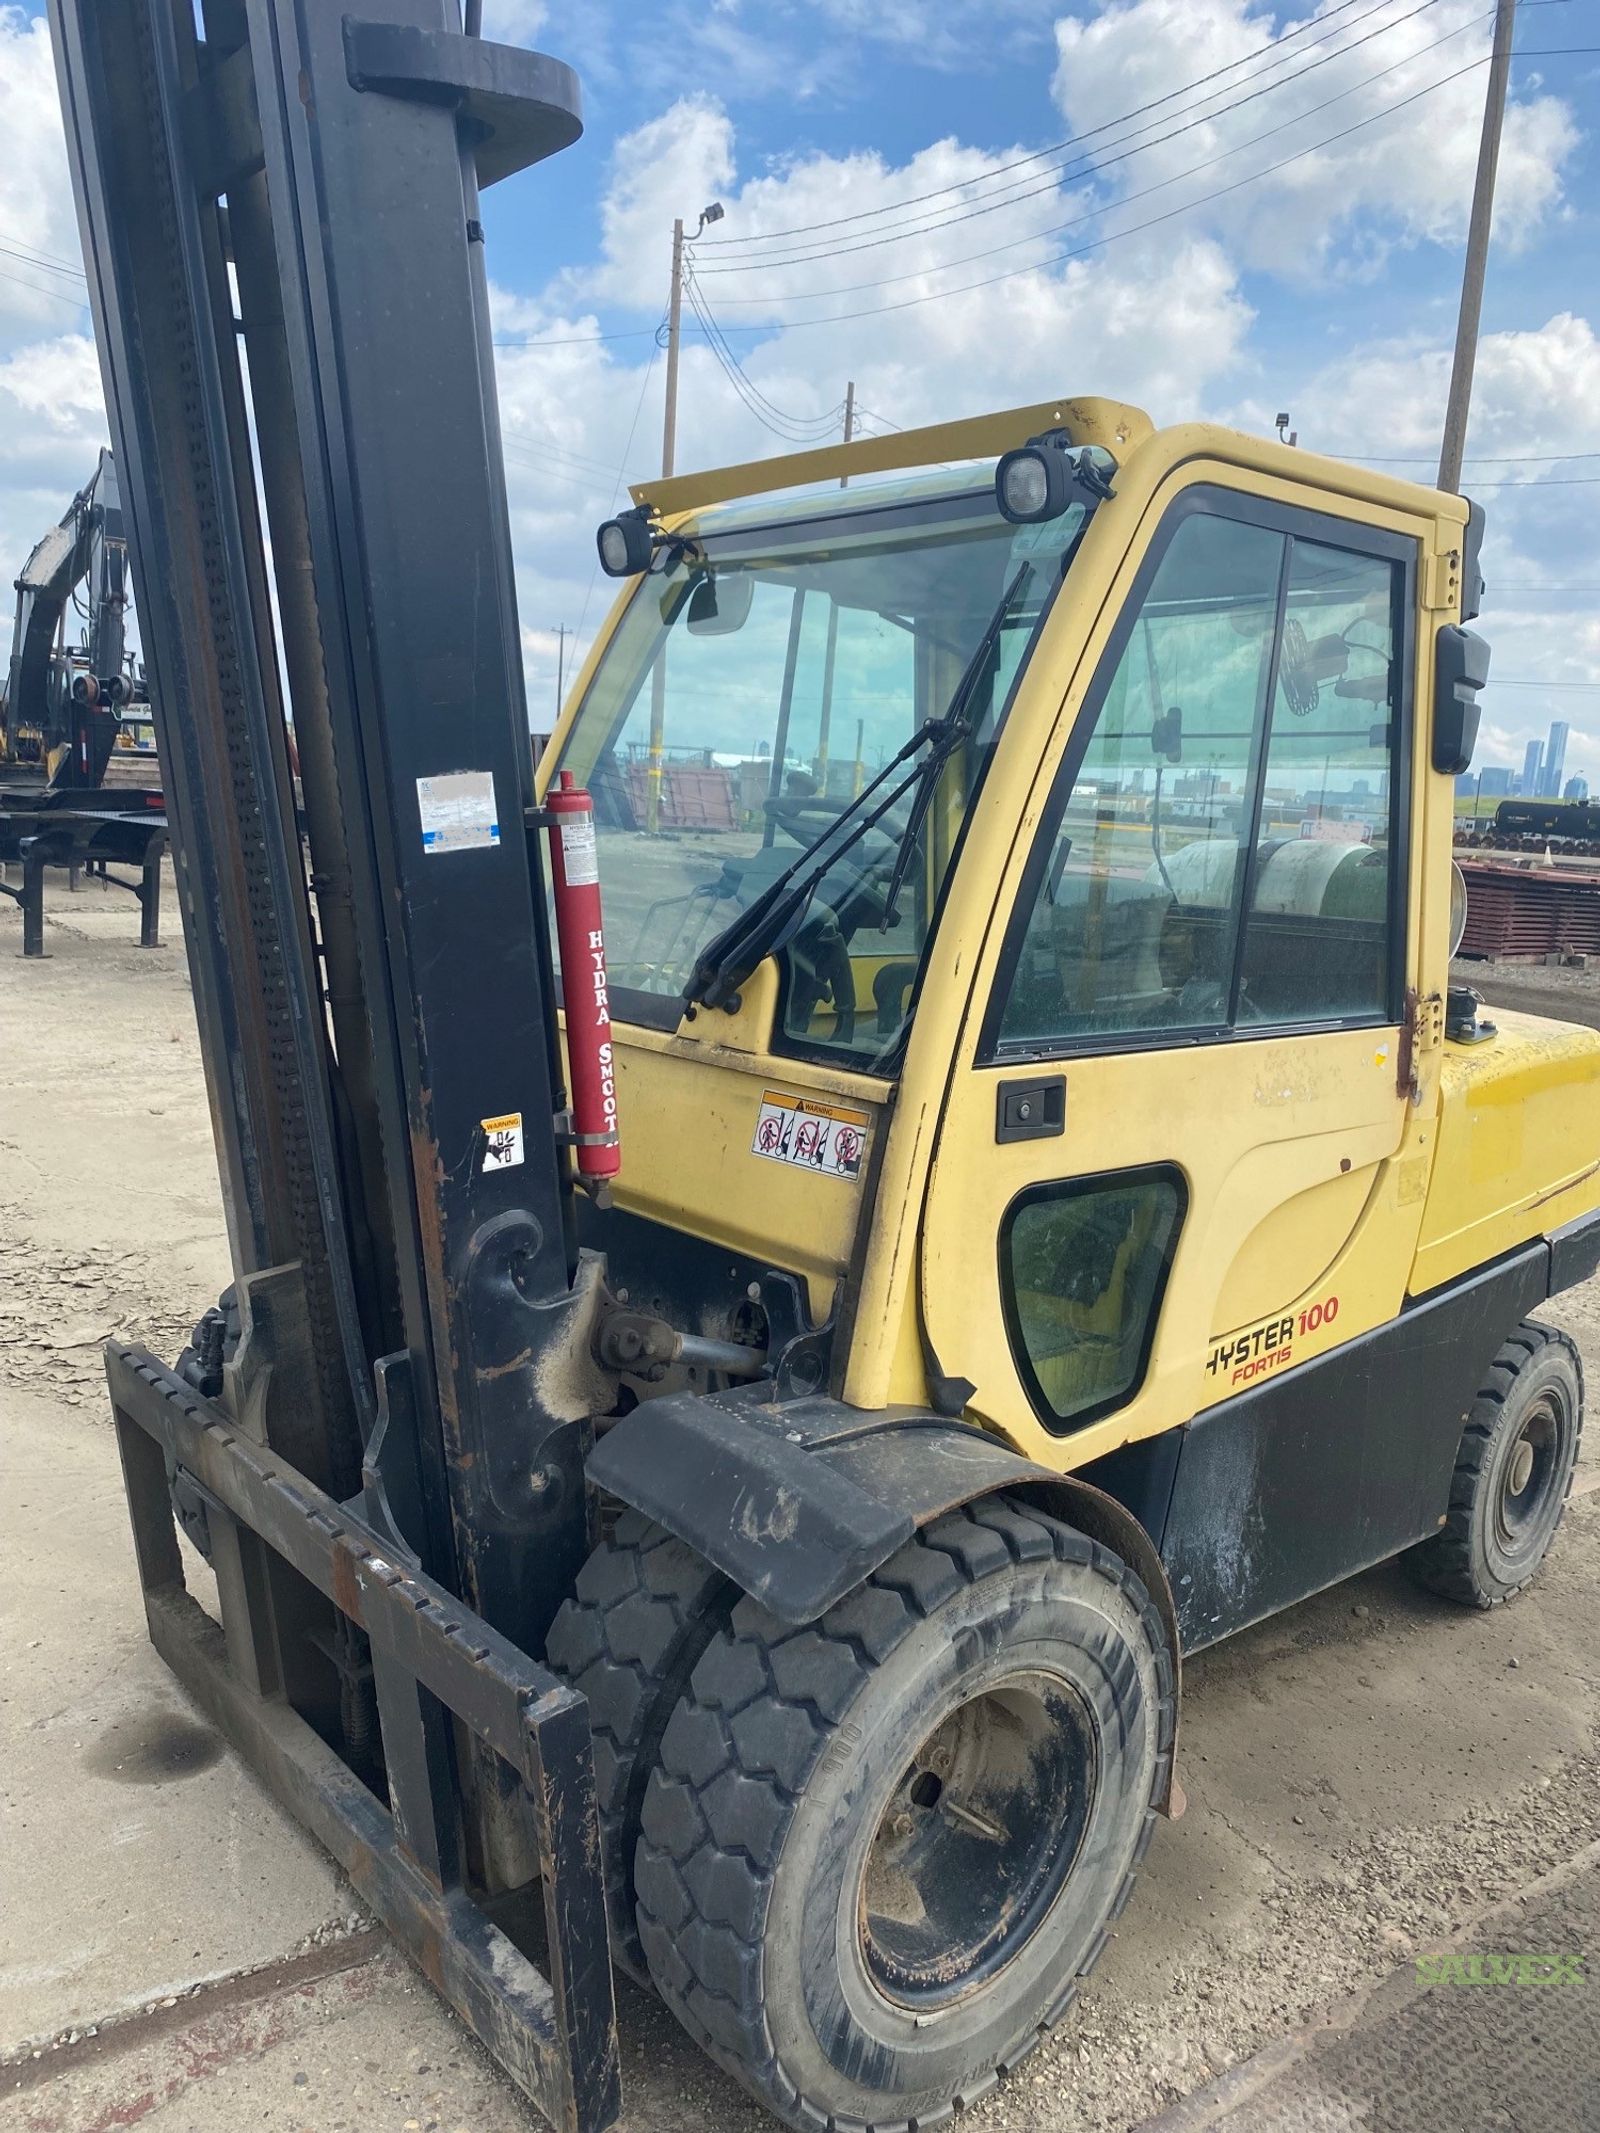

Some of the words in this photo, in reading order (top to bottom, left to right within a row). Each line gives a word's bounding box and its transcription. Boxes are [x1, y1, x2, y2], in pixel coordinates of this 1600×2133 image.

[588, 930, 610, 1025] HYDRA
[599, 1043, 619, 1148] SMOOT
[486, 1118, 519, 1130] WARNING
[805, 1103, 834, 1116] WARNING
[1204, 1315, 1294, 1376] HYSTER
[1298, 1296, 1339, 1336] 100
[1231, 1345, 1292, 1386] FORTIS
